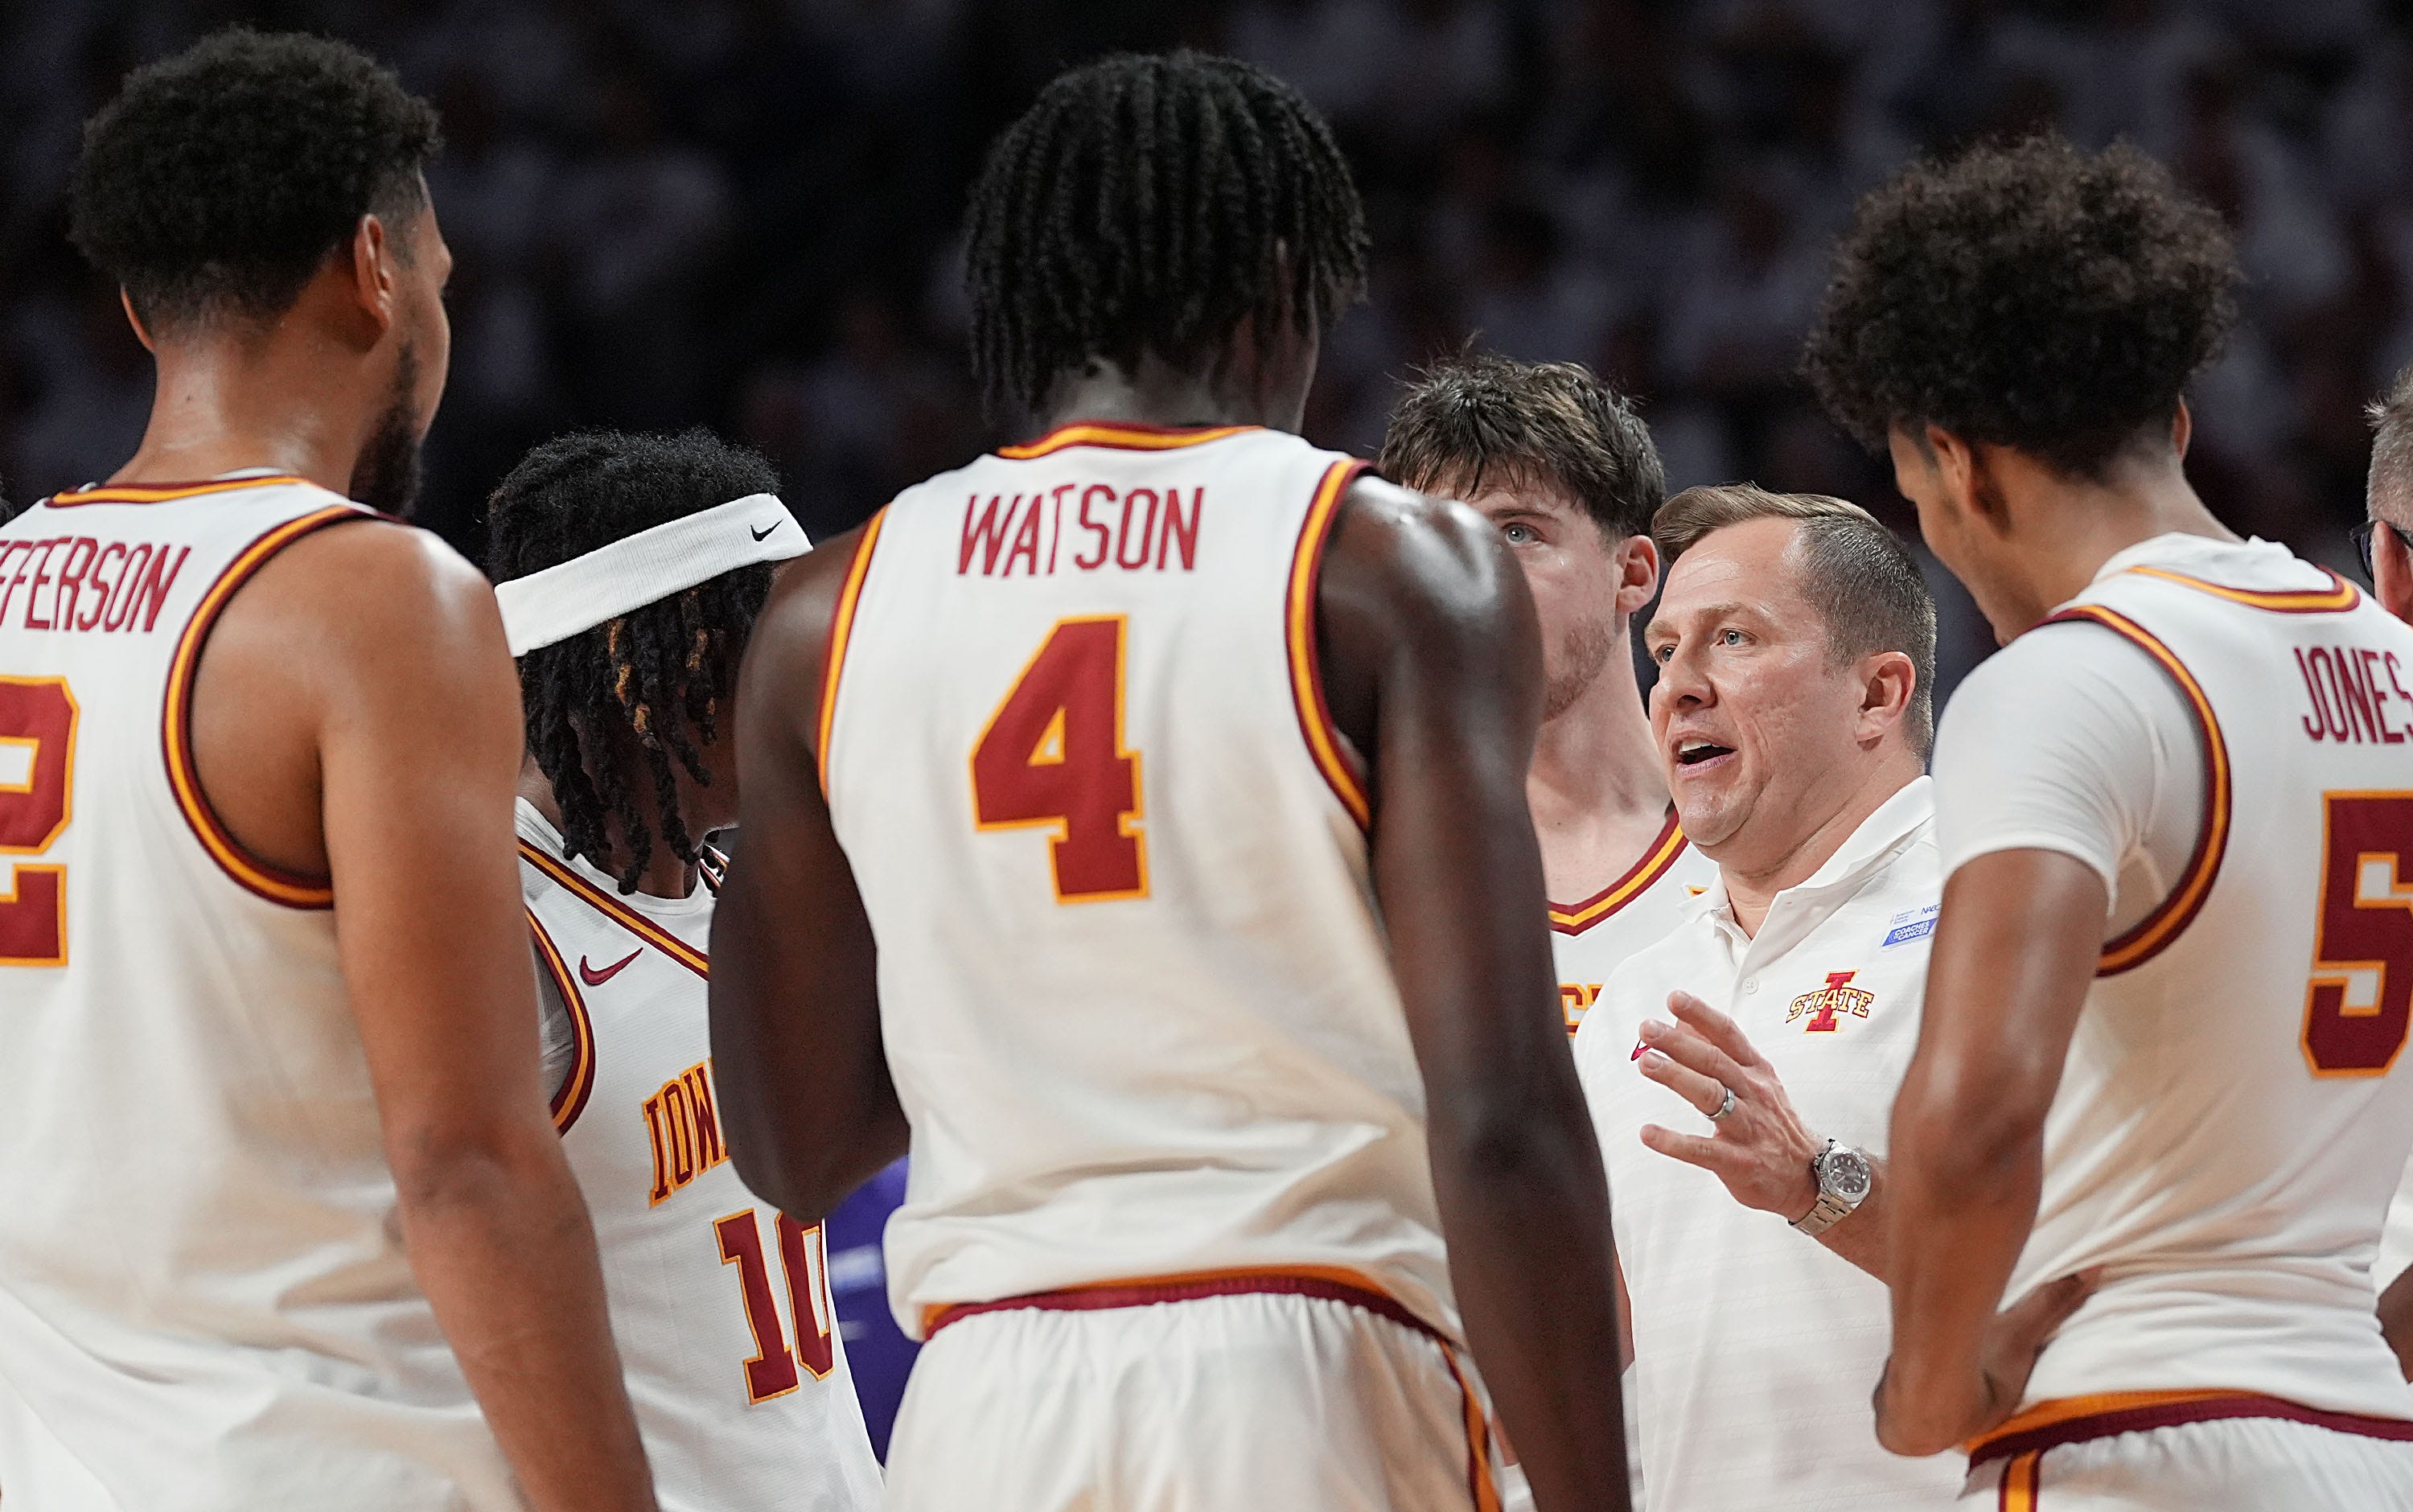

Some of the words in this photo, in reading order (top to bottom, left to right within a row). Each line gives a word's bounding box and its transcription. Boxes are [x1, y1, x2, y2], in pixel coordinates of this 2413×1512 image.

[956, 483, 1205, 577] WATSON
[2294, 646, 2413, 744] JONES
[968, 614, 1150, 905] 4
[1894, 921, 1930, 936] COACHES
[1897, 927, 1928, 941] CANCER
[2300, 789, 2413, 1079] 5
[1786, 988, 1875, 1023] STATE
[642, 1057, 730, 1209] IOW
[713, 1207, 834, 1405] 10
